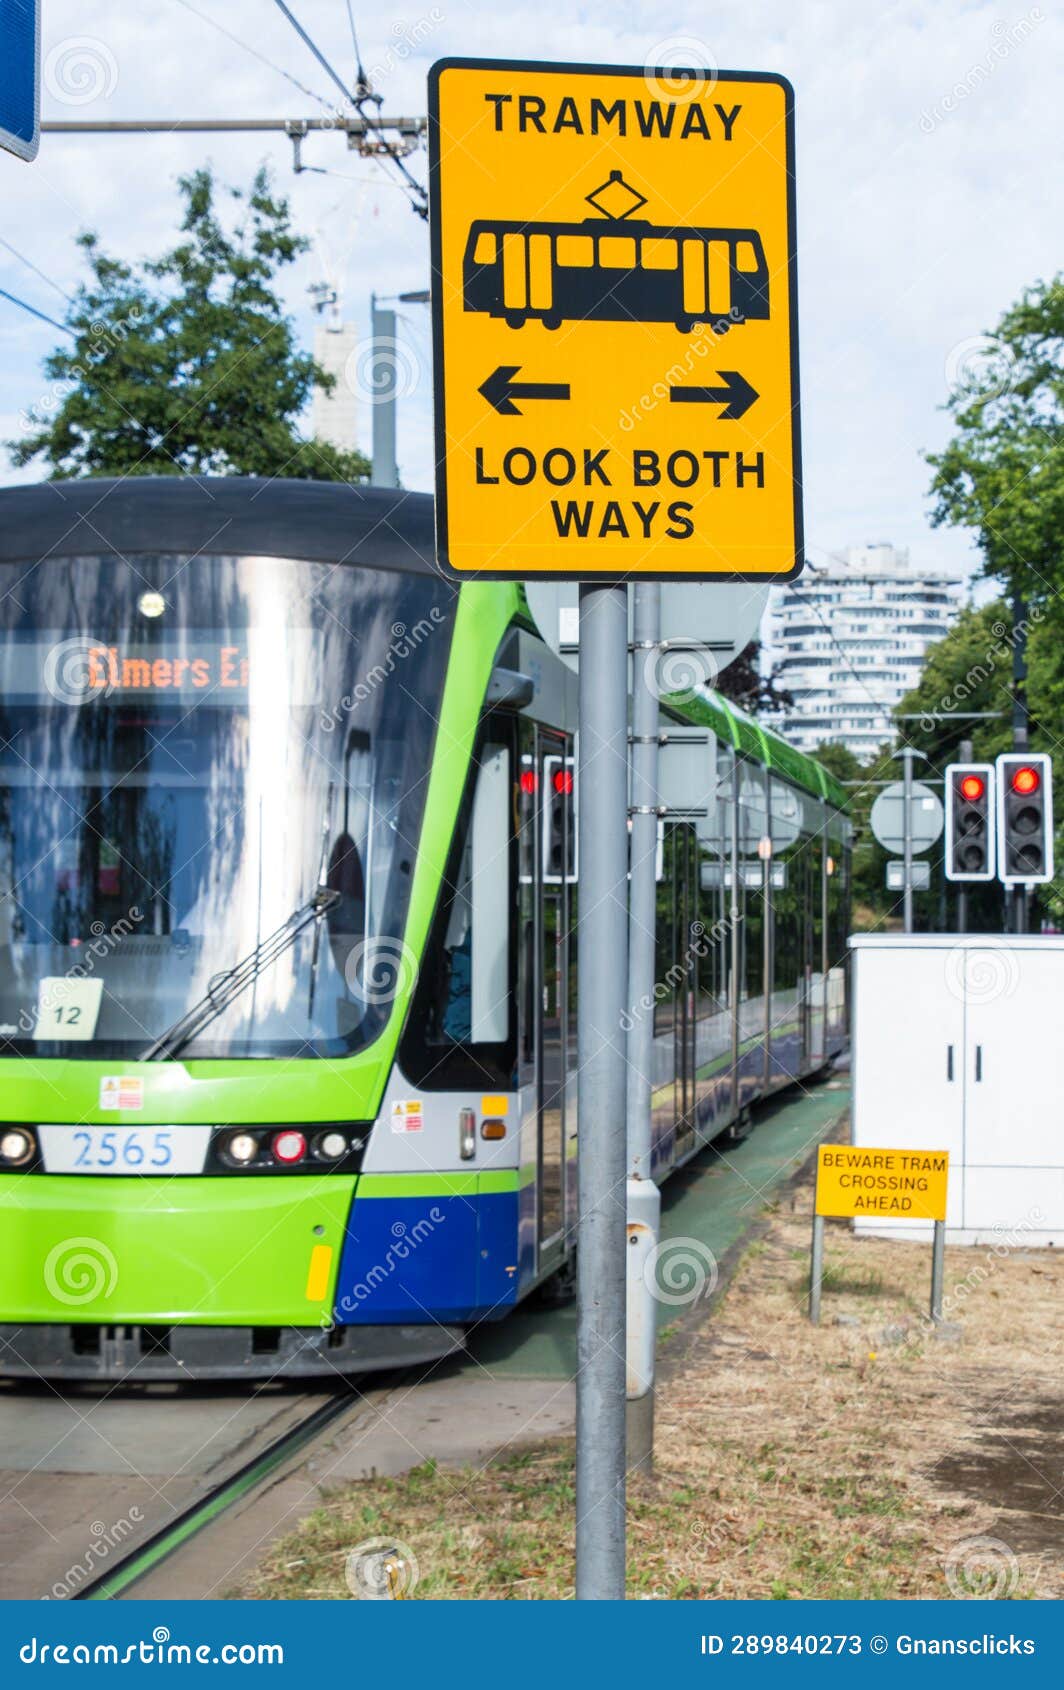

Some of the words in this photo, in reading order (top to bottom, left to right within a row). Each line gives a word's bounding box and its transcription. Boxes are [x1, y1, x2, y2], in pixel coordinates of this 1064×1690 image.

[485, 94, 742, 141] TRAMWAY
[475, 447, 612, 487] LOOK
[633, 450, 765, 489] BOTH
[551, 501, 694, 540] WAYS
[88, 647, 210, 688] Elmers
[54, 1006, 82, 1025] 12
[73, 1132, 172, 1166] 2565
[823, 1153, 895, 1170] BEWARE
[901, 1157, 946, 1172] TRAM
[839, 1174, 929, 1192] CROSSING
[854, 1195, 912, 1211] AHEAD
